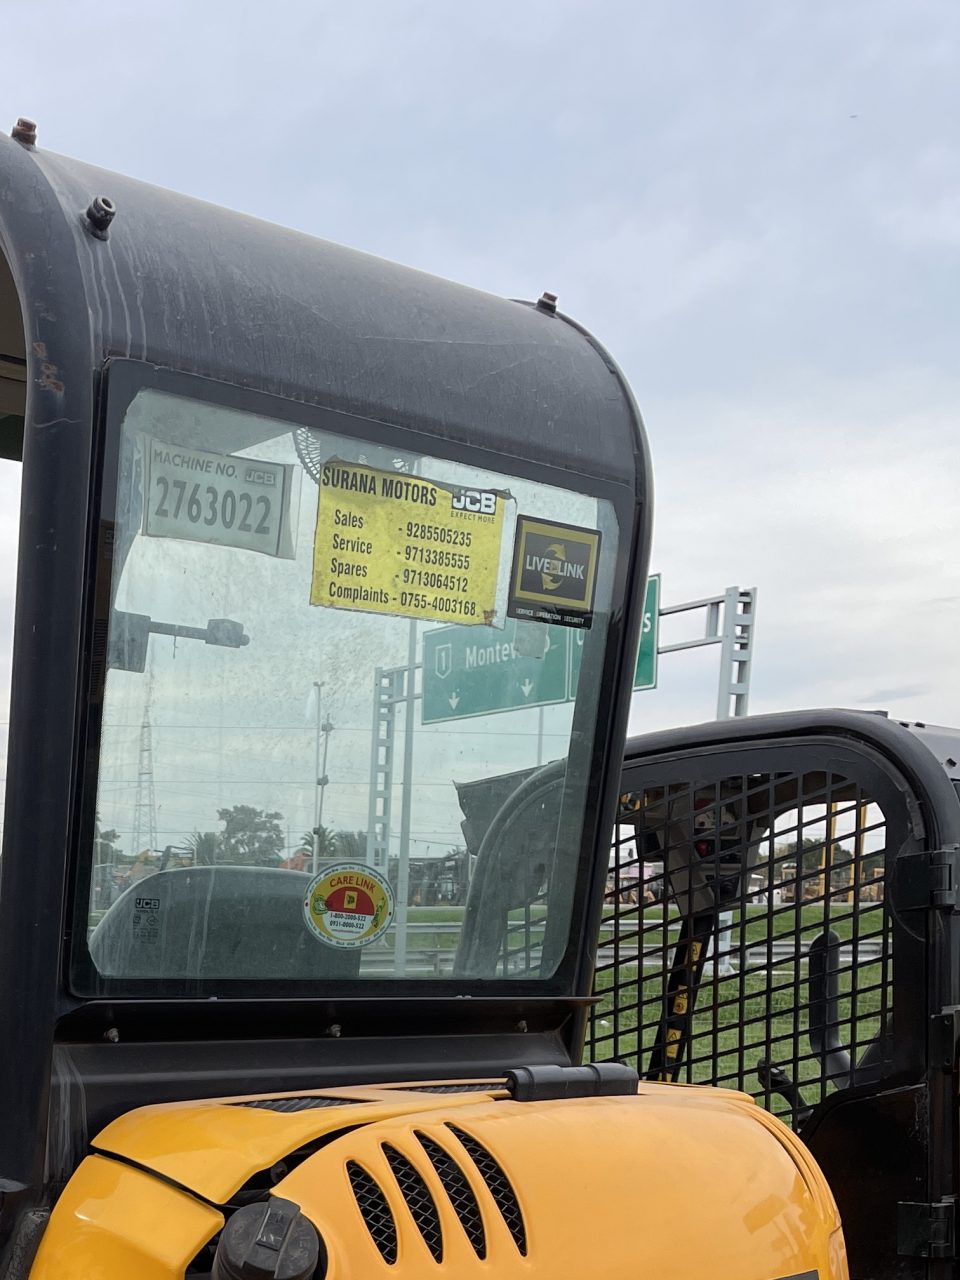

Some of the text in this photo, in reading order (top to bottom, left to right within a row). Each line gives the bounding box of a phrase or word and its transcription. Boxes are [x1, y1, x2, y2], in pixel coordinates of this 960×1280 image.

[153, 448, 238, 479] MACHINE NO.
[246, 468, 276, 486] JCB
[322, 465, 438, 507] SURANA MOTORS
[154, 476, 272, 535] 2763022
[452, 489, 496, 514] JCB
[334, 508, 365, 530] Sales
[406, 521, 472, 548] 9285505235
[450, 510, 496, 525] EXPECT MORE
[332, 533, 373, 555] Service
[404, 545, 470, 570] 9713385555
[330, 557, 368, 578] Spares
[403, 568, 468, 593] 9713064512
[328, 581, 389, 604] Complaints
[329, 875, 377, 894] CARE LINK
[135, 897, 160, 910] JCB
